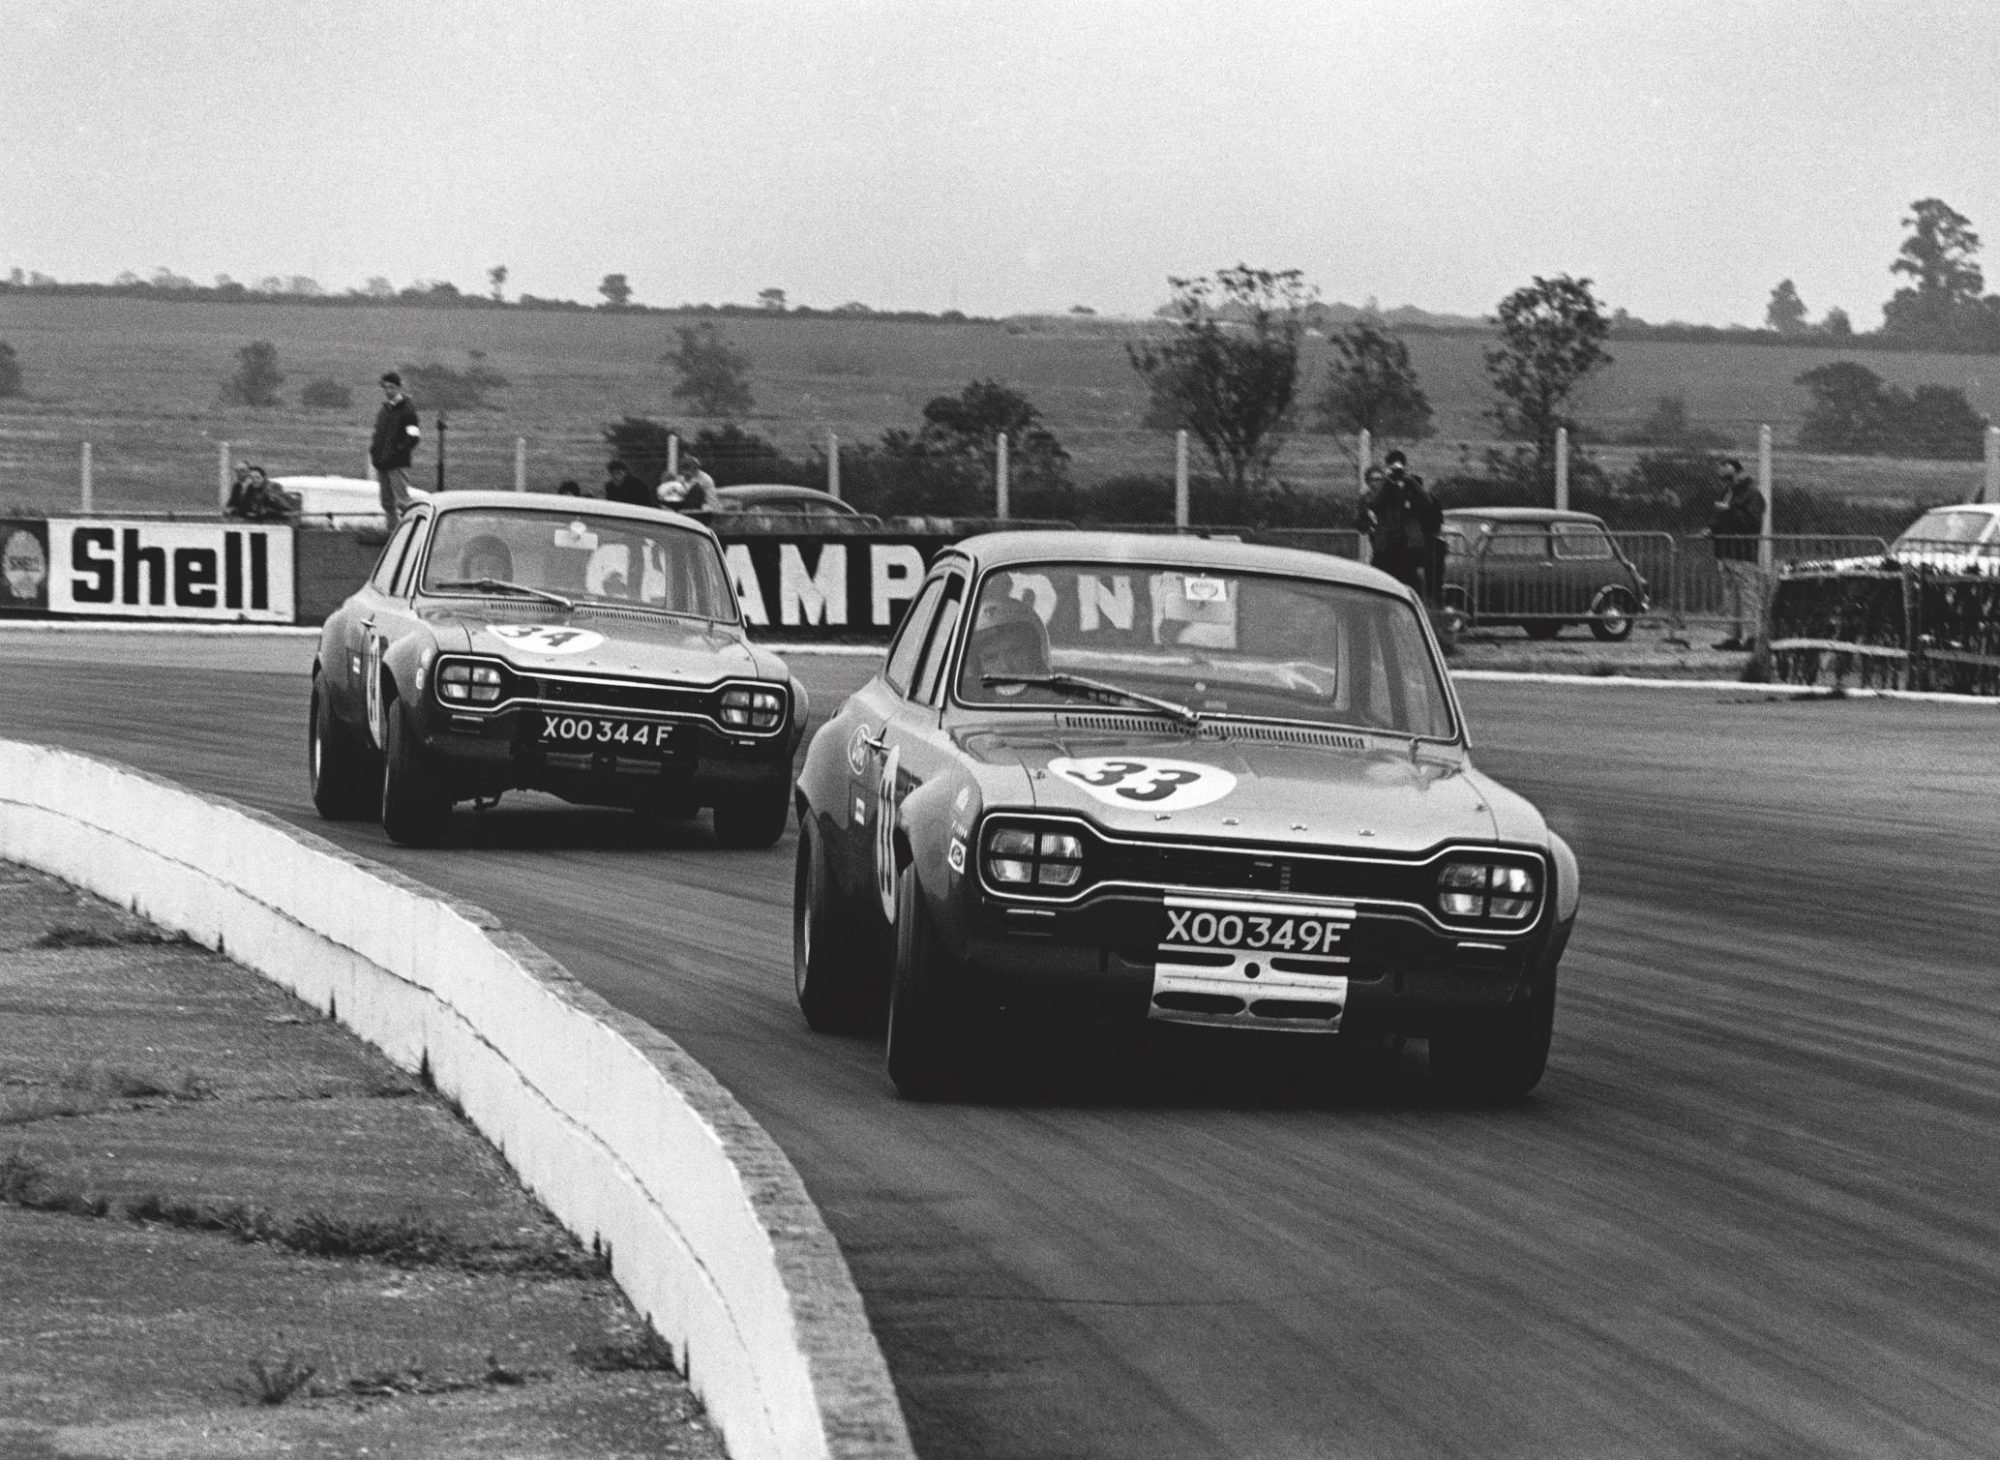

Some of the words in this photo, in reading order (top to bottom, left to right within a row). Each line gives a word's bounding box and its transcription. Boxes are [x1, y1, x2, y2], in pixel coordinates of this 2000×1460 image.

[72, 527, 268, 610] Shell
[497, 626, 584, 648] 34
[1066, 761, 1201, 801] 33
